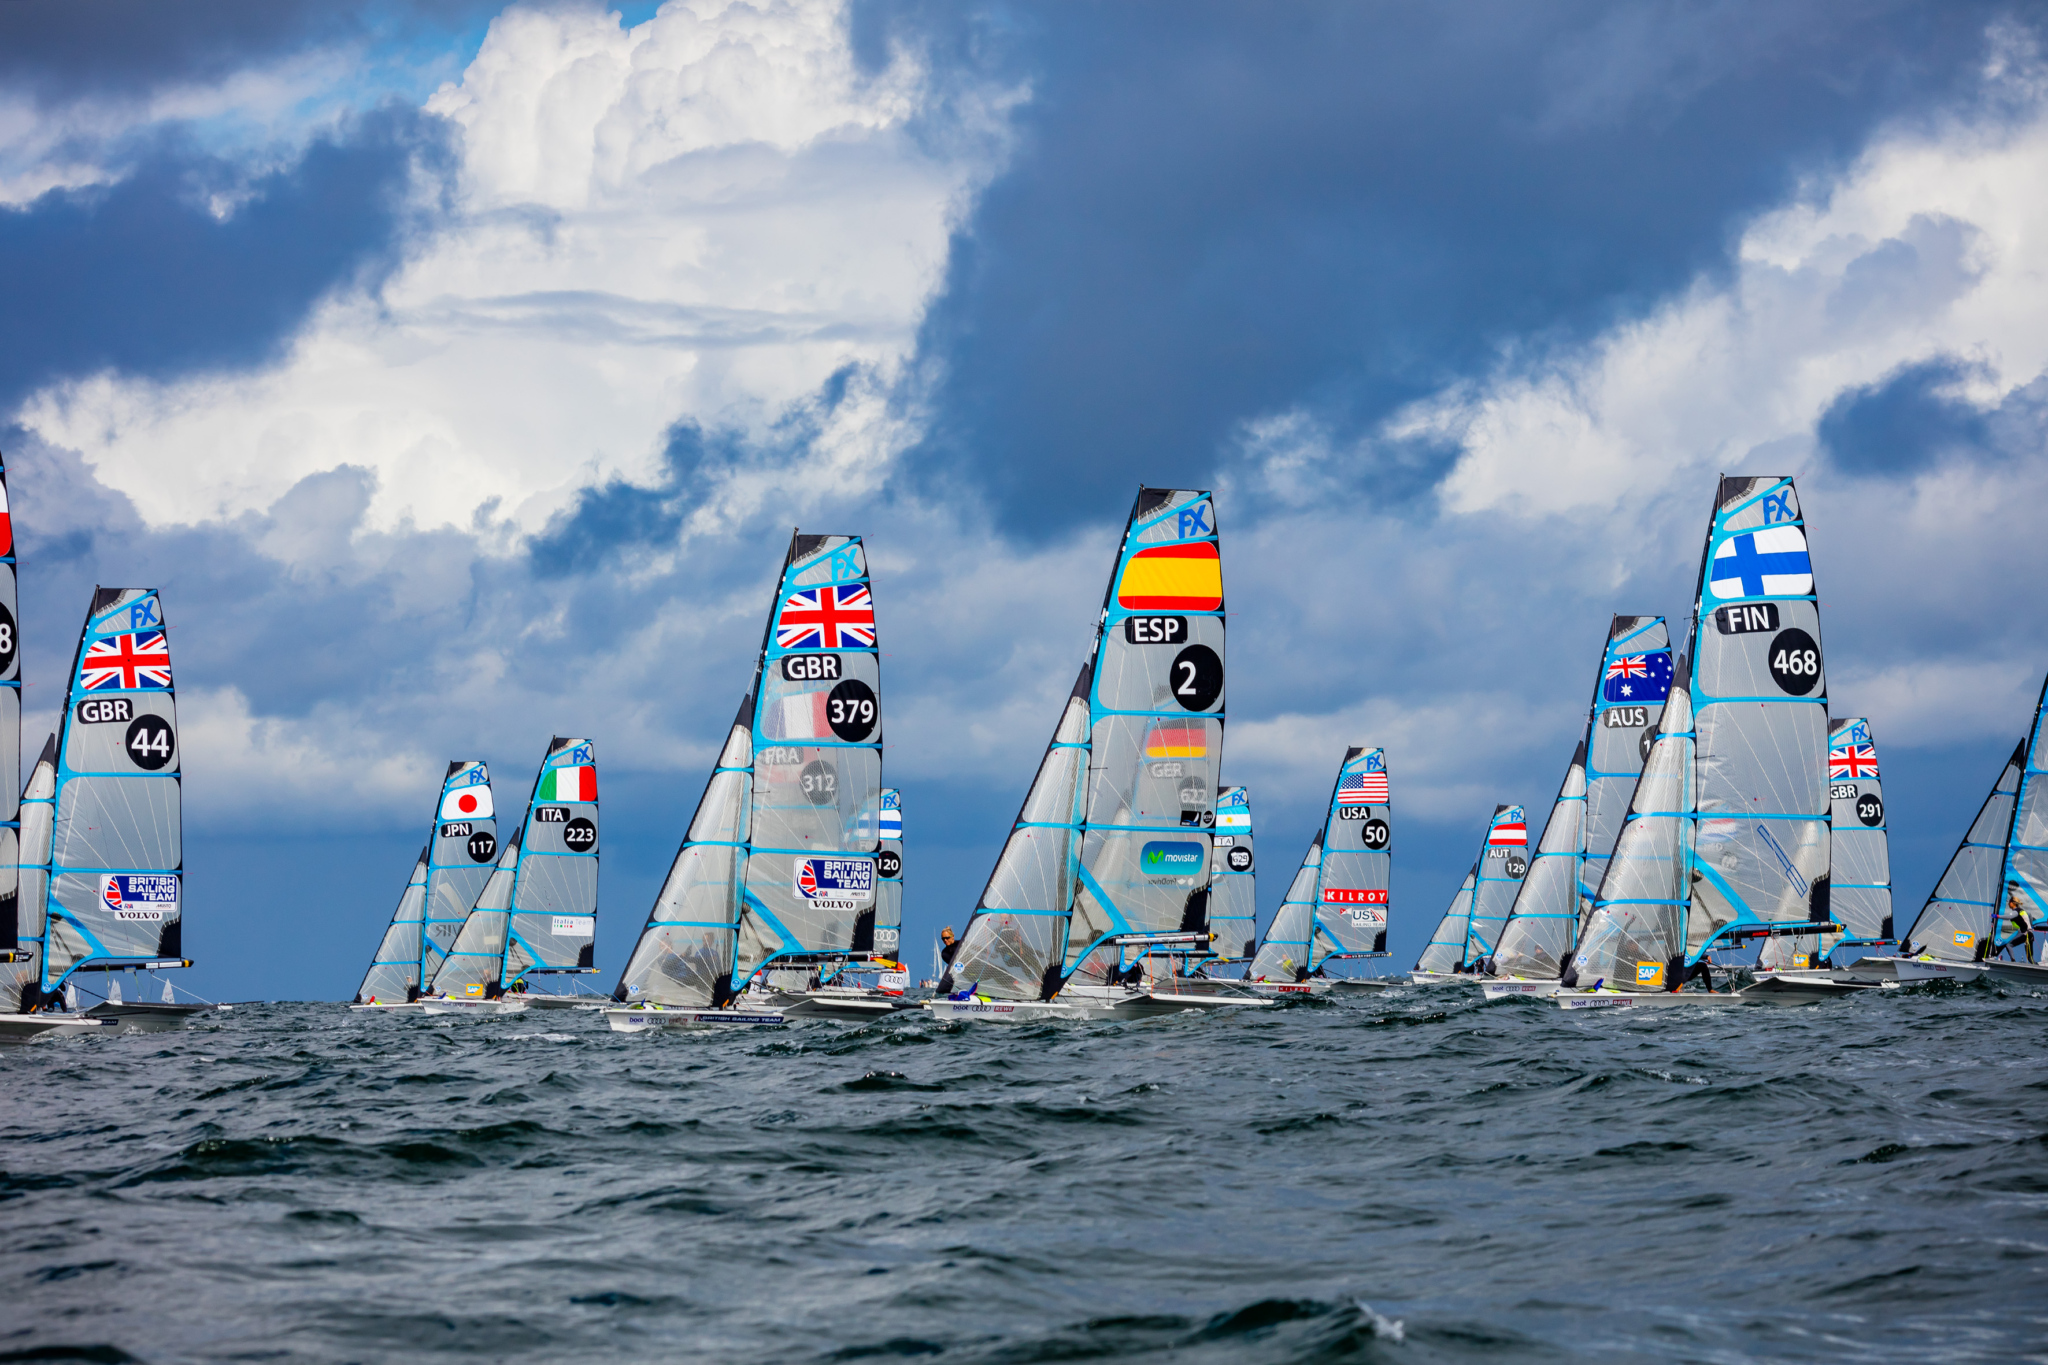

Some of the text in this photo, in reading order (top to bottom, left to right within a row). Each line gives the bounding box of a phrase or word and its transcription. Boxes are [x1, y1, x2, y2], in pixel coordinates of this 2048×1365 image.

[1762, 489, 1796, 526] FX
[1178, 504, 1211, 540] FX
[830, 547, 862, 582] FX
[130, 599, 158, 630] FX
[1727, 605, 1770, 633] FIN
[1133, 618, 1180, 642] ESP
[786, 656, 838, 679] GBR
[1773, 649, 1817, 676] 468
[1177, 660, 1197, 695] 2
[81, 700, 129, 722] GBR
[831, 699, 874, 724] 379
[1608, 708, 1645, 727] AUS
[1851, 724, 1869, 743] FX
[131, 728, 170, 757] 44
[572, 746, 591, 764] FX
[765, 747, 800, 765] FRA
[1366, 754, 1383, 770] FX
[470, 767, 486, 785] FX
[1151, 762, 1183, 778] GER
[803, 774, 835, 793] 312
[1231, 791, 1246, 806] FX
[1830, 785, 1856, 799] GBR
[882, 794, 898, 809] FX
[542, 808, 564, 822] ITA
[1342, 807, 1368, 820] USA
[1510, 809, 1524, 822] FX
[1859, 803, 1881, 818] 291
[444, 823, 470, 838] JPN
[566, 828, 594, 842] 223
[1364, 825, 1387, 843] 50
[470, 840, 494, 854] 117
[1489, 848, 1510, 859] AUT
[878, 858, 899, 871] 120
[1164, 853, 1199, 863] movistar
[1231, 854, 1248, 864] 629
[824, 861, 871, 871] BRITISH
[1507, 862, 1526, 874] 129
[128, 876, 175, 885] BRITISH
[823, 870, 870, 880] SAILING
[128, 885, 175, 893] SAILING
[836, 879, 870, 889] TEAM
[141, 893, 175, 901] TEAM
[1327, 890, 1386, 902] KILROY
[813, 900, 854, 909] VOLVO
[118, 911, 160, 920] VOLVO
[1638, 967, 1656, 979] SAP
[1571, 999, 1587, 1007] boot
